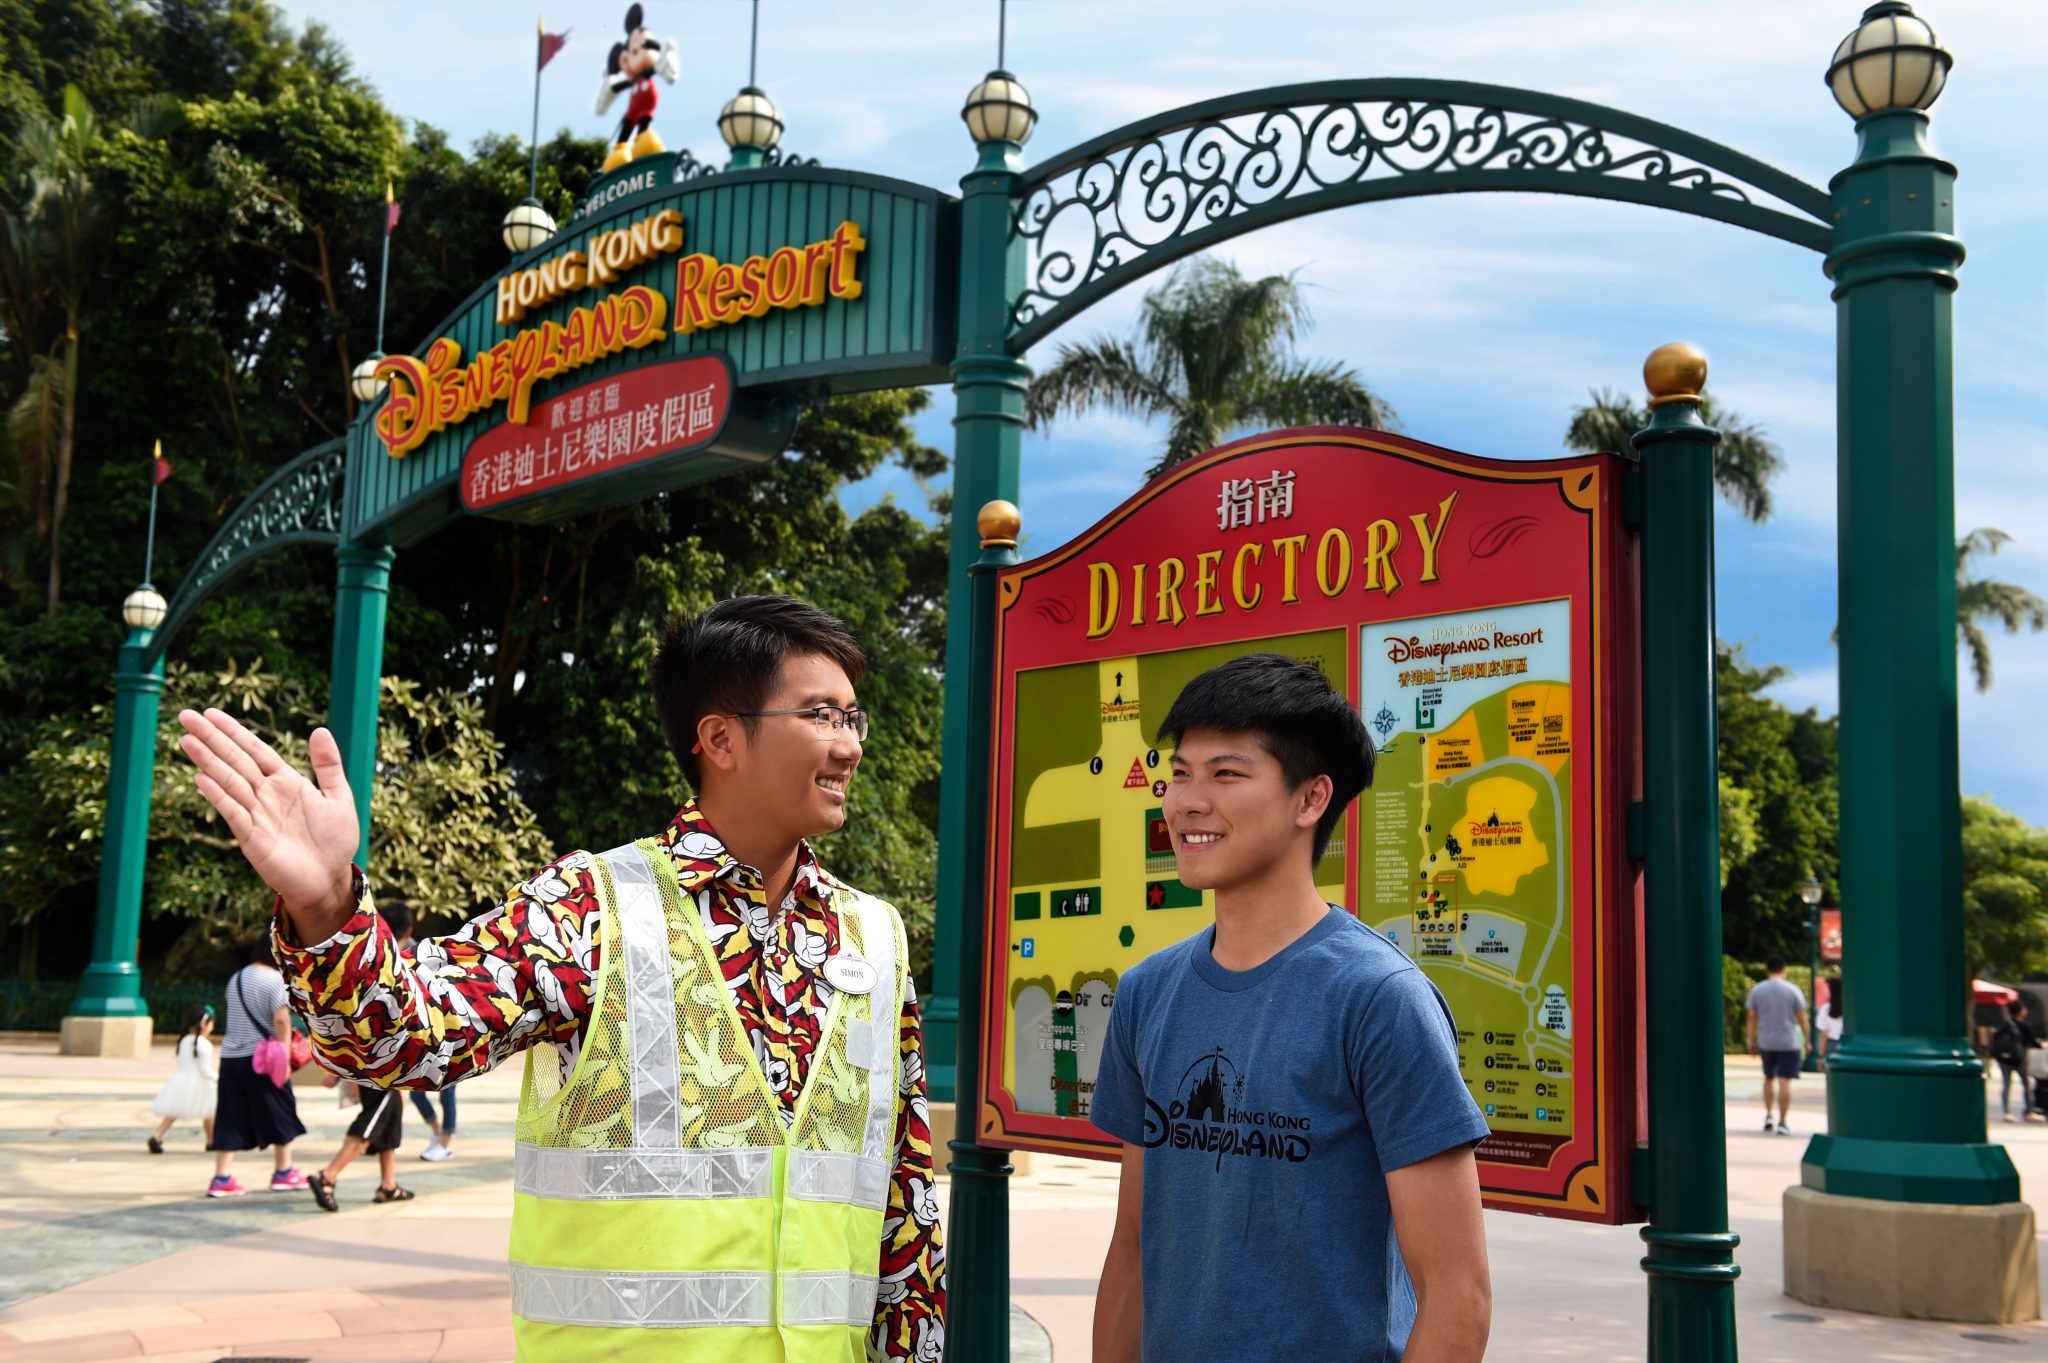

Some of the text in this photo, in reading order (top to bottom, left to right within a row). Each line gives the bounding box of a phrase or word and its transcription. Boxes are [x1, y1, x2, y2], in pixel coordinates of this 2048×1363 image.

[496, 208, 684, 324] HONG KONG
[673, 220, 866, 335] Resort
[470, 383, 715, 503] 香港迪士尼樂園度假區
[1216, 469, 1297, 532] 指南
[1086, 490, 1460, 640] DIRECTORY
[1430, 621, 1498, 641] HONG KONG
[1493, 627, 1544, 649] Resort
[840, 968, 864, 979] SIMON
[1227, 1107, 1311, 1131] HONG KONG
